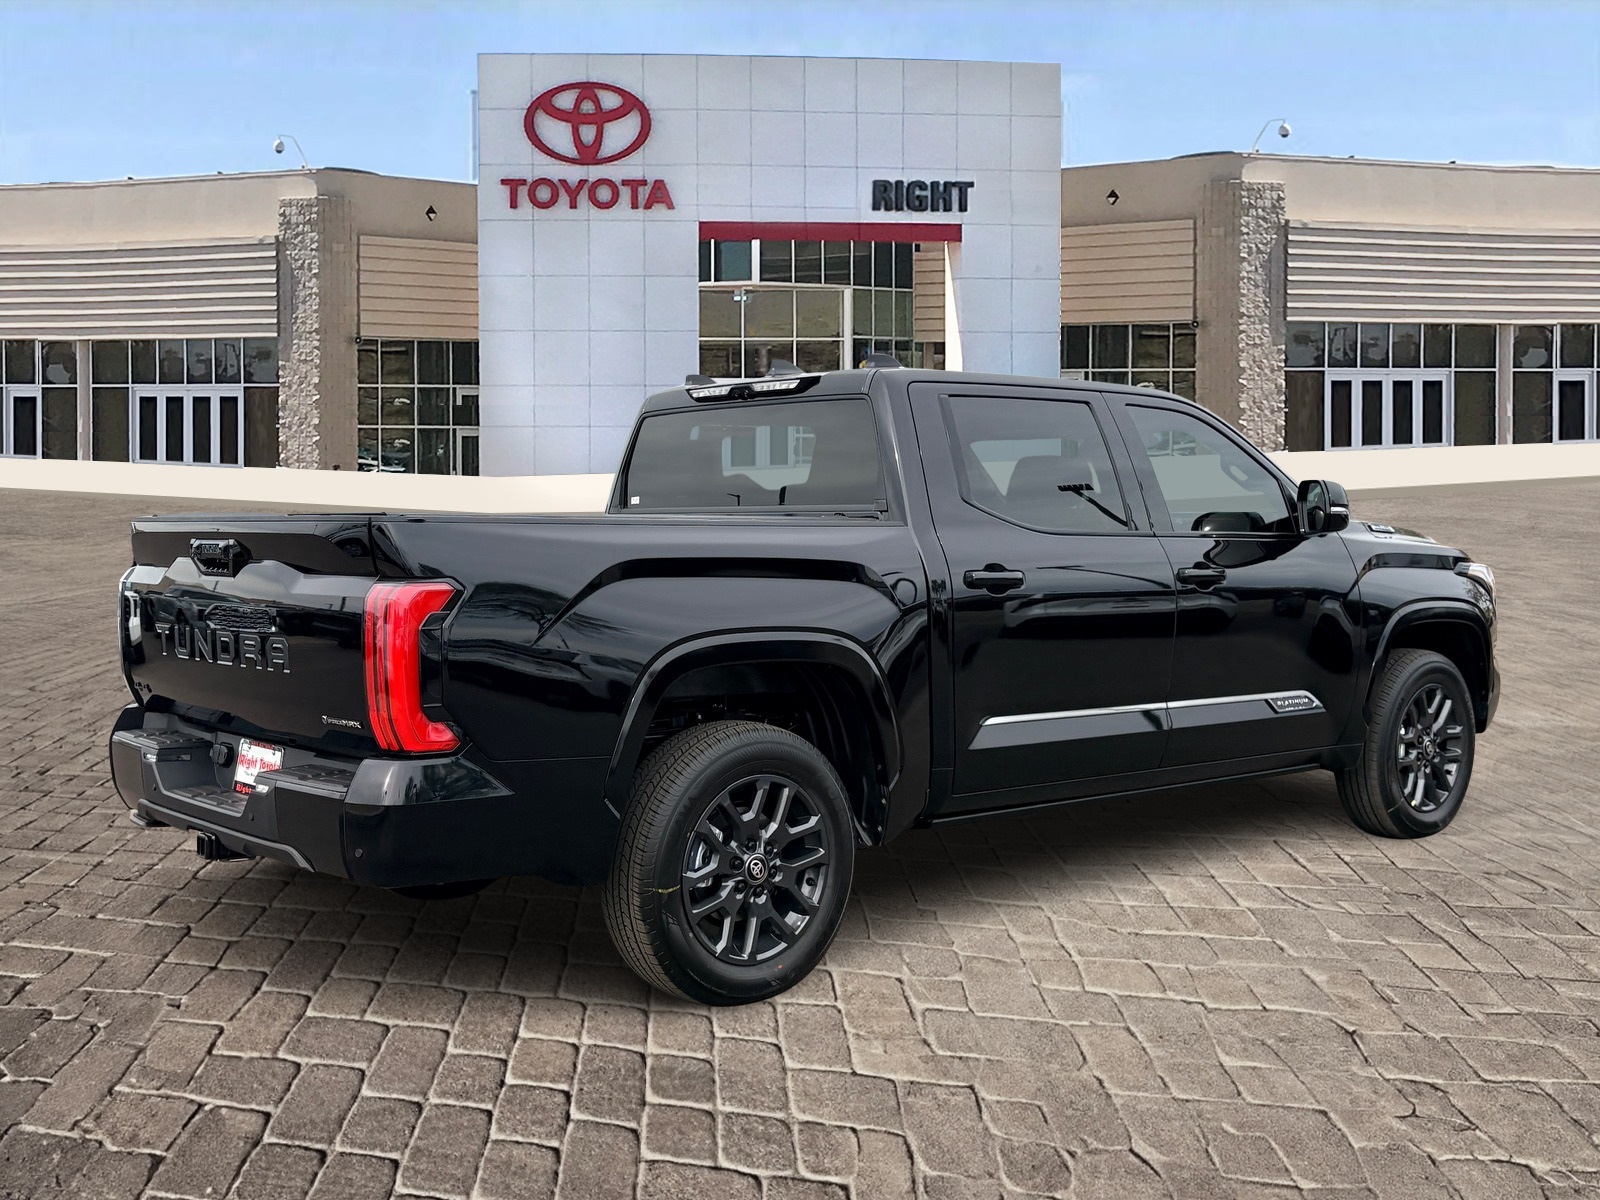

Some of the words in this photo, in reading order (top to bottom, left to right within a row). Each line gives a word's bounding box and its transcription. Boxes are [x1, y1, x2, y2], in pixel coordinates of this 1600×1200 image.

[500, 178, 675, 211] TOYOTA
[871, 179, 975, 213] RIGHT
[155, 623, 290, 673] TUNDRA
[1277, 698, 1308, 706] PLATINUM
[239, 754, 258, 770] Right
